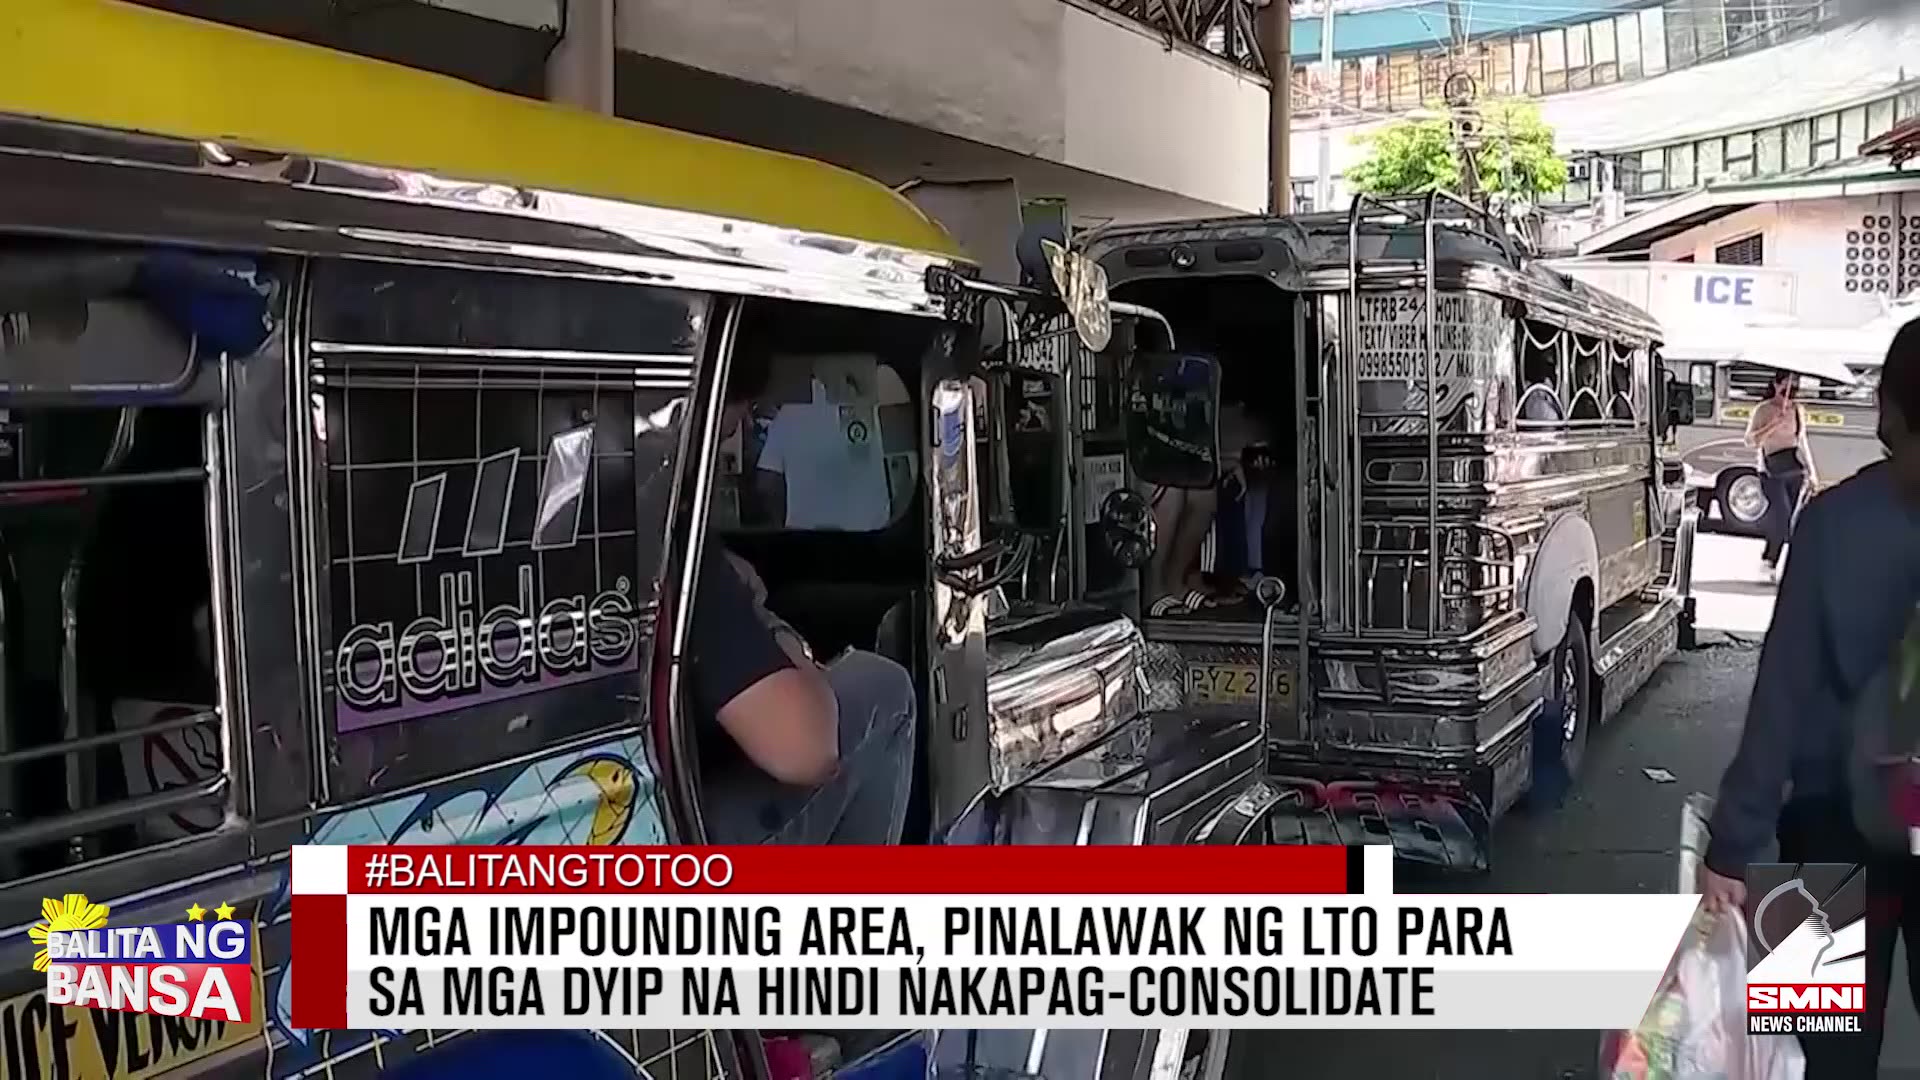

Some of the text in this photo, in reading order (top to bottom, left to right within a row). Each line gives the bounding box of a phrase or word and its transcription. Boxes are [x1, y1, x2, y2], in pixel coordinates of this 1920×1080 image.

[1694, 275, 1754, 305] ICE
[1359, 297, 1397, 322] LTFRB
[1359, 352, 1441, 377] 0998550132
[336, 565, 638, 706] adidas
